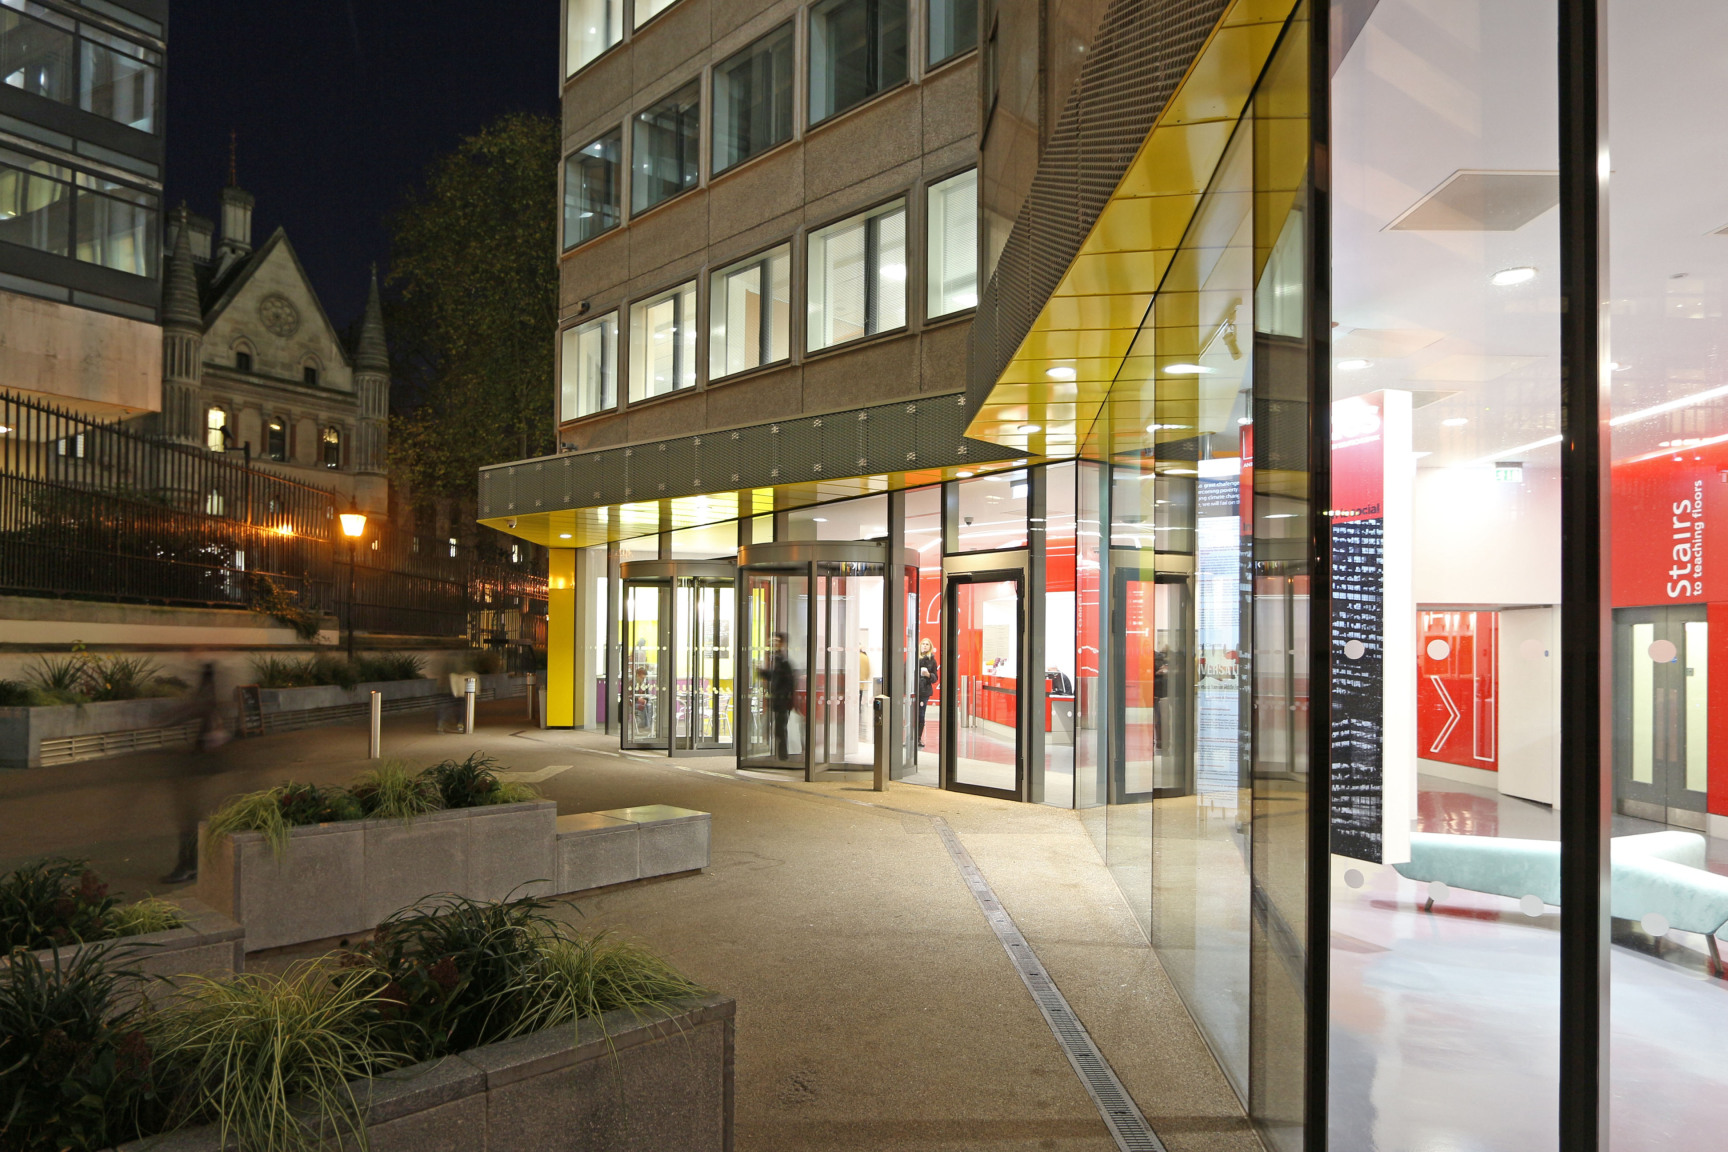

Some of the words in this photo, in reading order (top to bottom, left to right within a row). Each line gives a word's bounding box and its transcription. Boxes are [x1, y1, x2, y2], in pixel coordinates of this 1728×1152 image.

[1692, 480, 1703, 518] floors
[1667, 499, 1692, 598] Stairs
[1692, 522, 1705, 578] teaching
[1692, 582, 1703, 596] to
